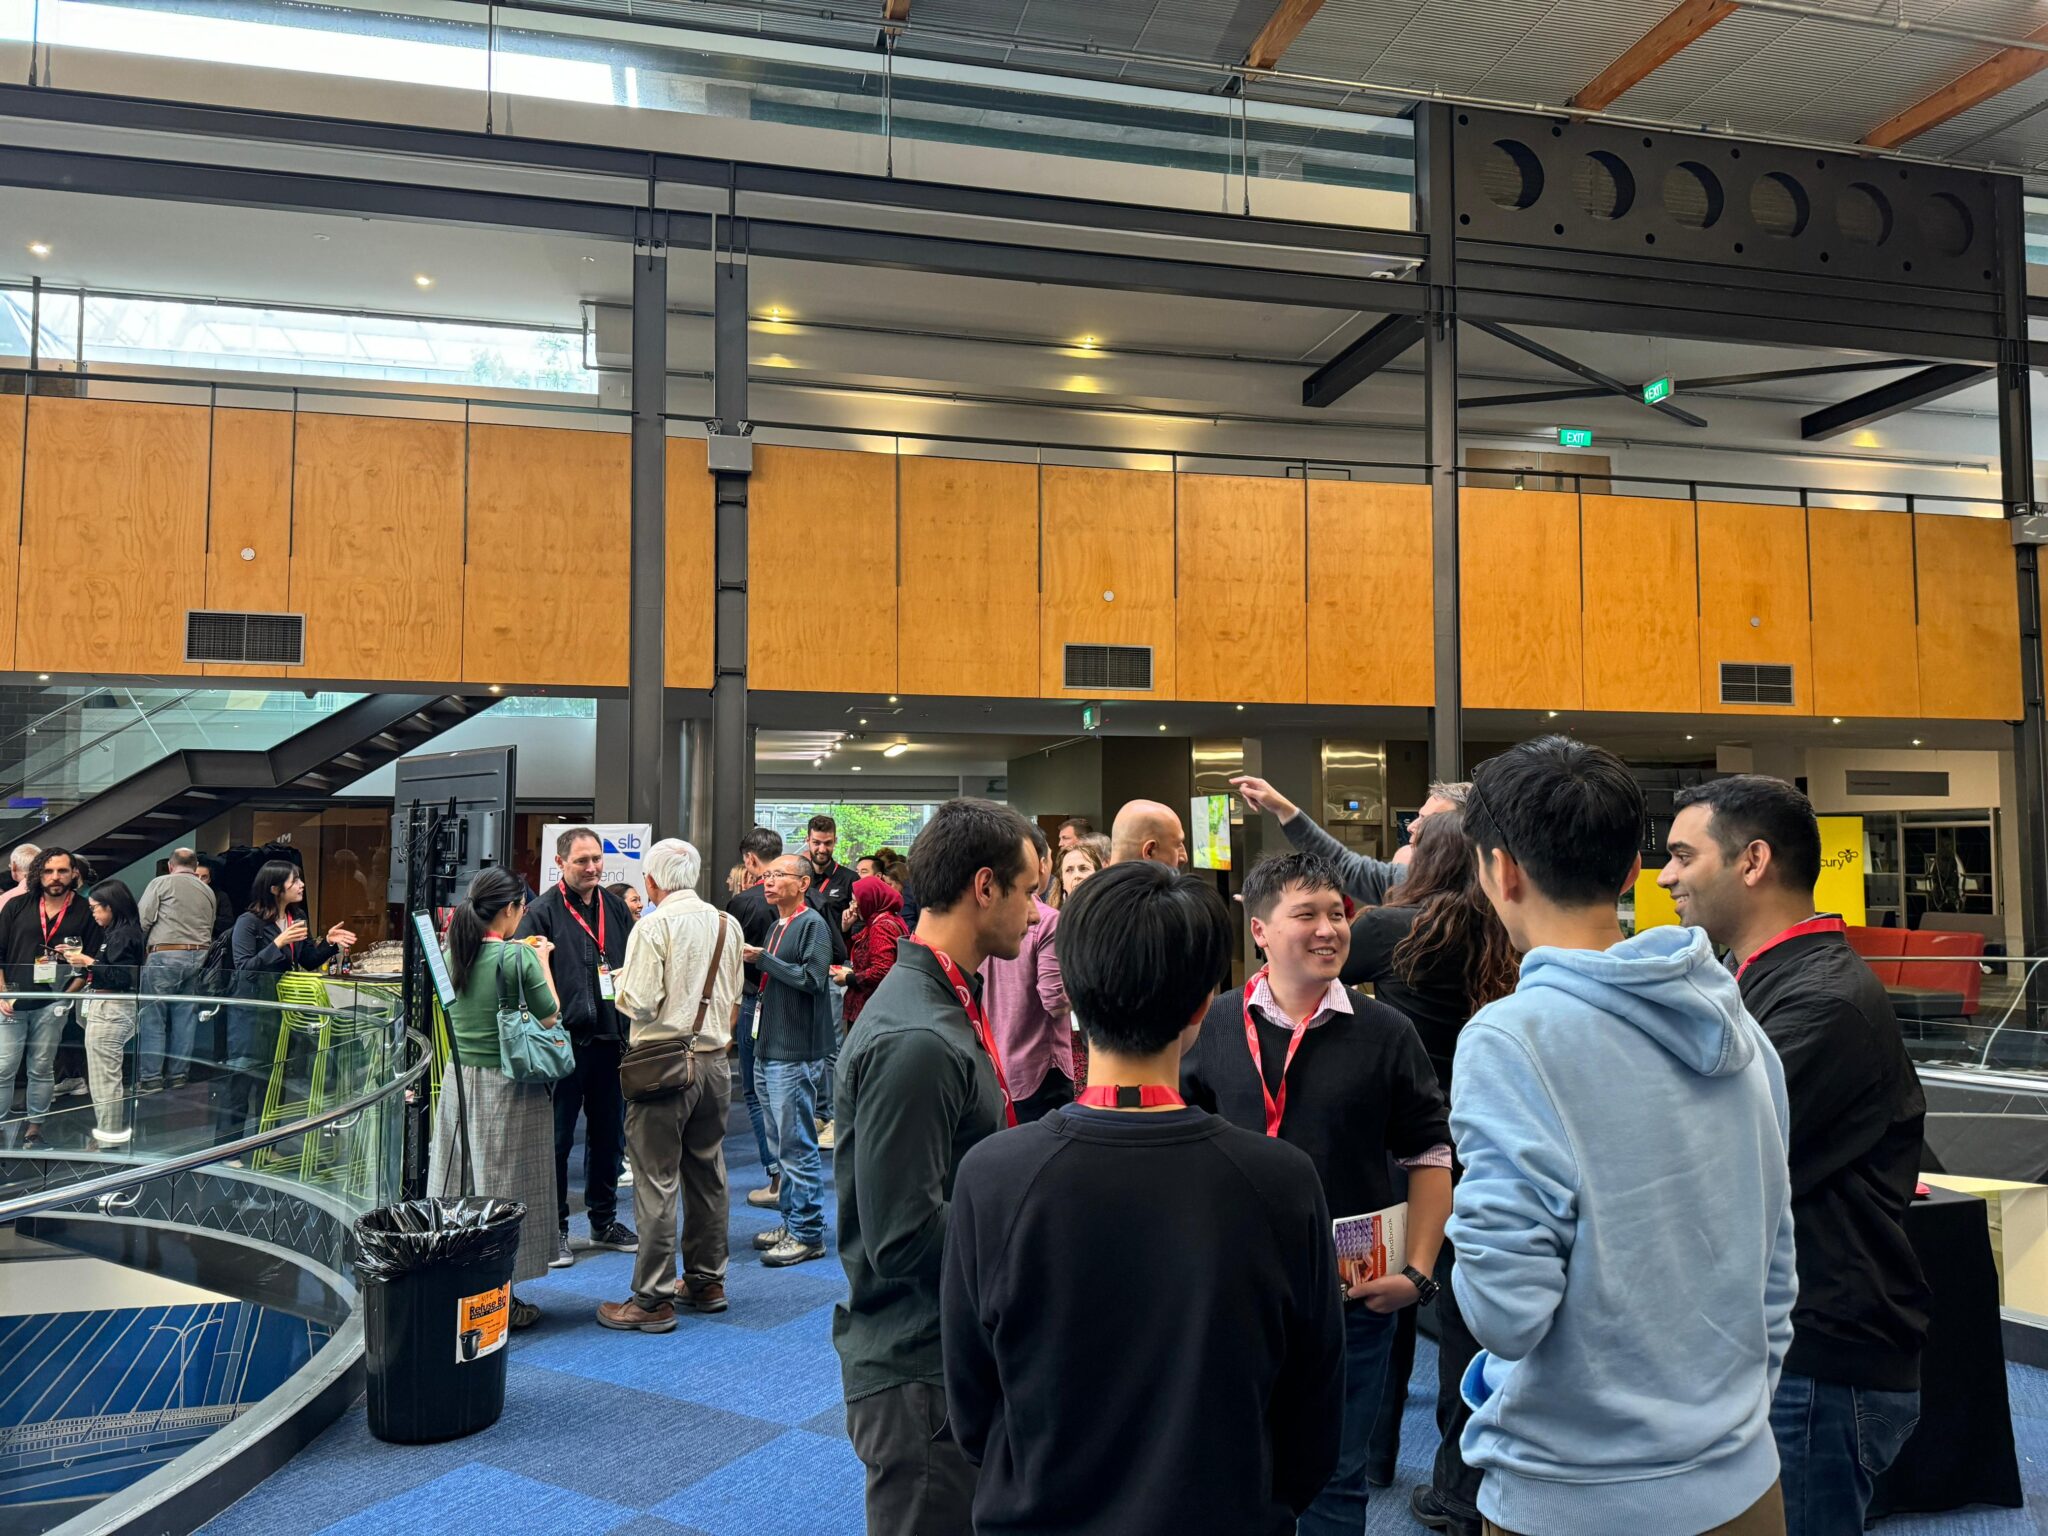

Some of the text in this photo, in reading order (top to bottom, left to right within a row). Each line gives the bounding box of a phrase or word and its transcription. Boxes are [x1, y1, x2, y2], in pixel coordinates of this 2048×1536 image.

[1648, 383, 1664, 400] EXIT
[1567, 432, 1584, 444] EXIT
[618, 834, 641, 849] slb
[1820, 859, 1844, 870] cury
[1387, 1218, 1395, 1262] Handbook
[470, 1301, 496, 1316] Refuse
